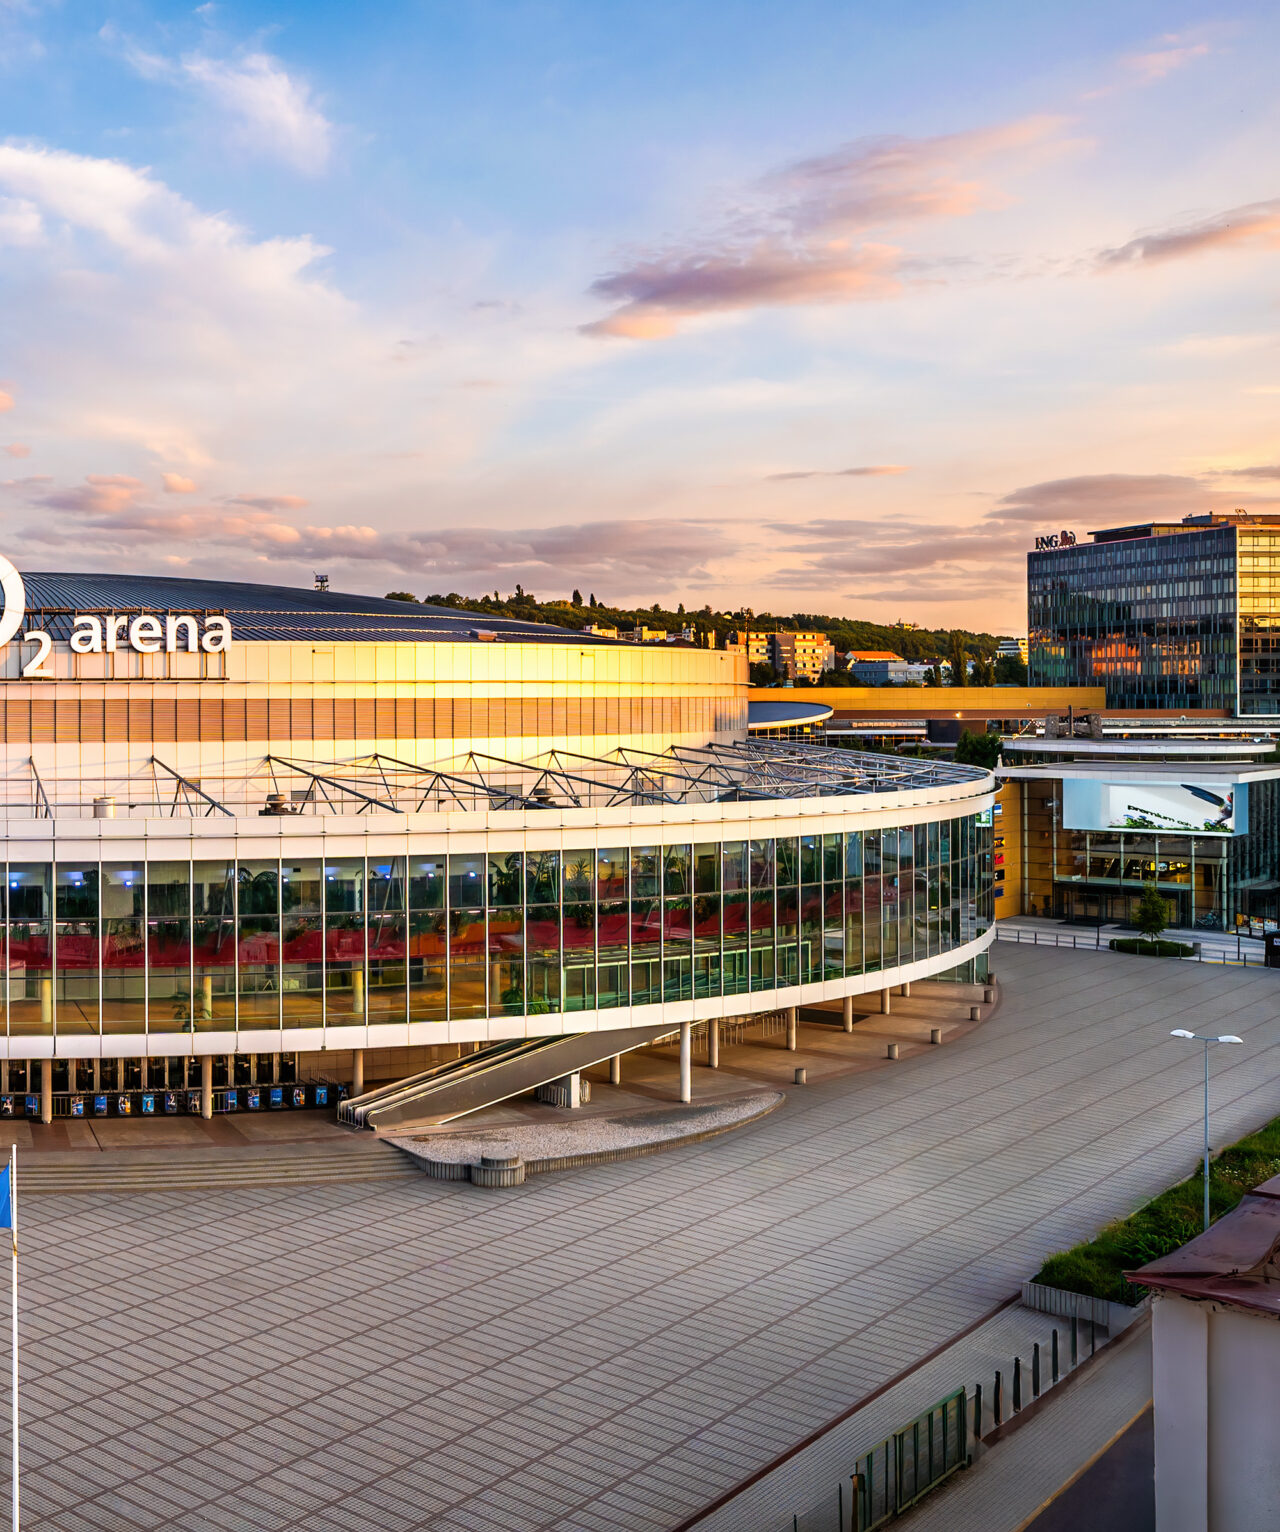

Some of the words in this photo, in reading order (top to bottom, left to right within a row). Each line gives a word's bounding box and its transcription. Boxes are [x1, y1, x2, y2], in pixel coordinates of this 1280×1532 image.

[1035, 535, 1058, 549] ING
[69, 615, 232, 653] arena
[1127, 805, 1175, 822] premium
